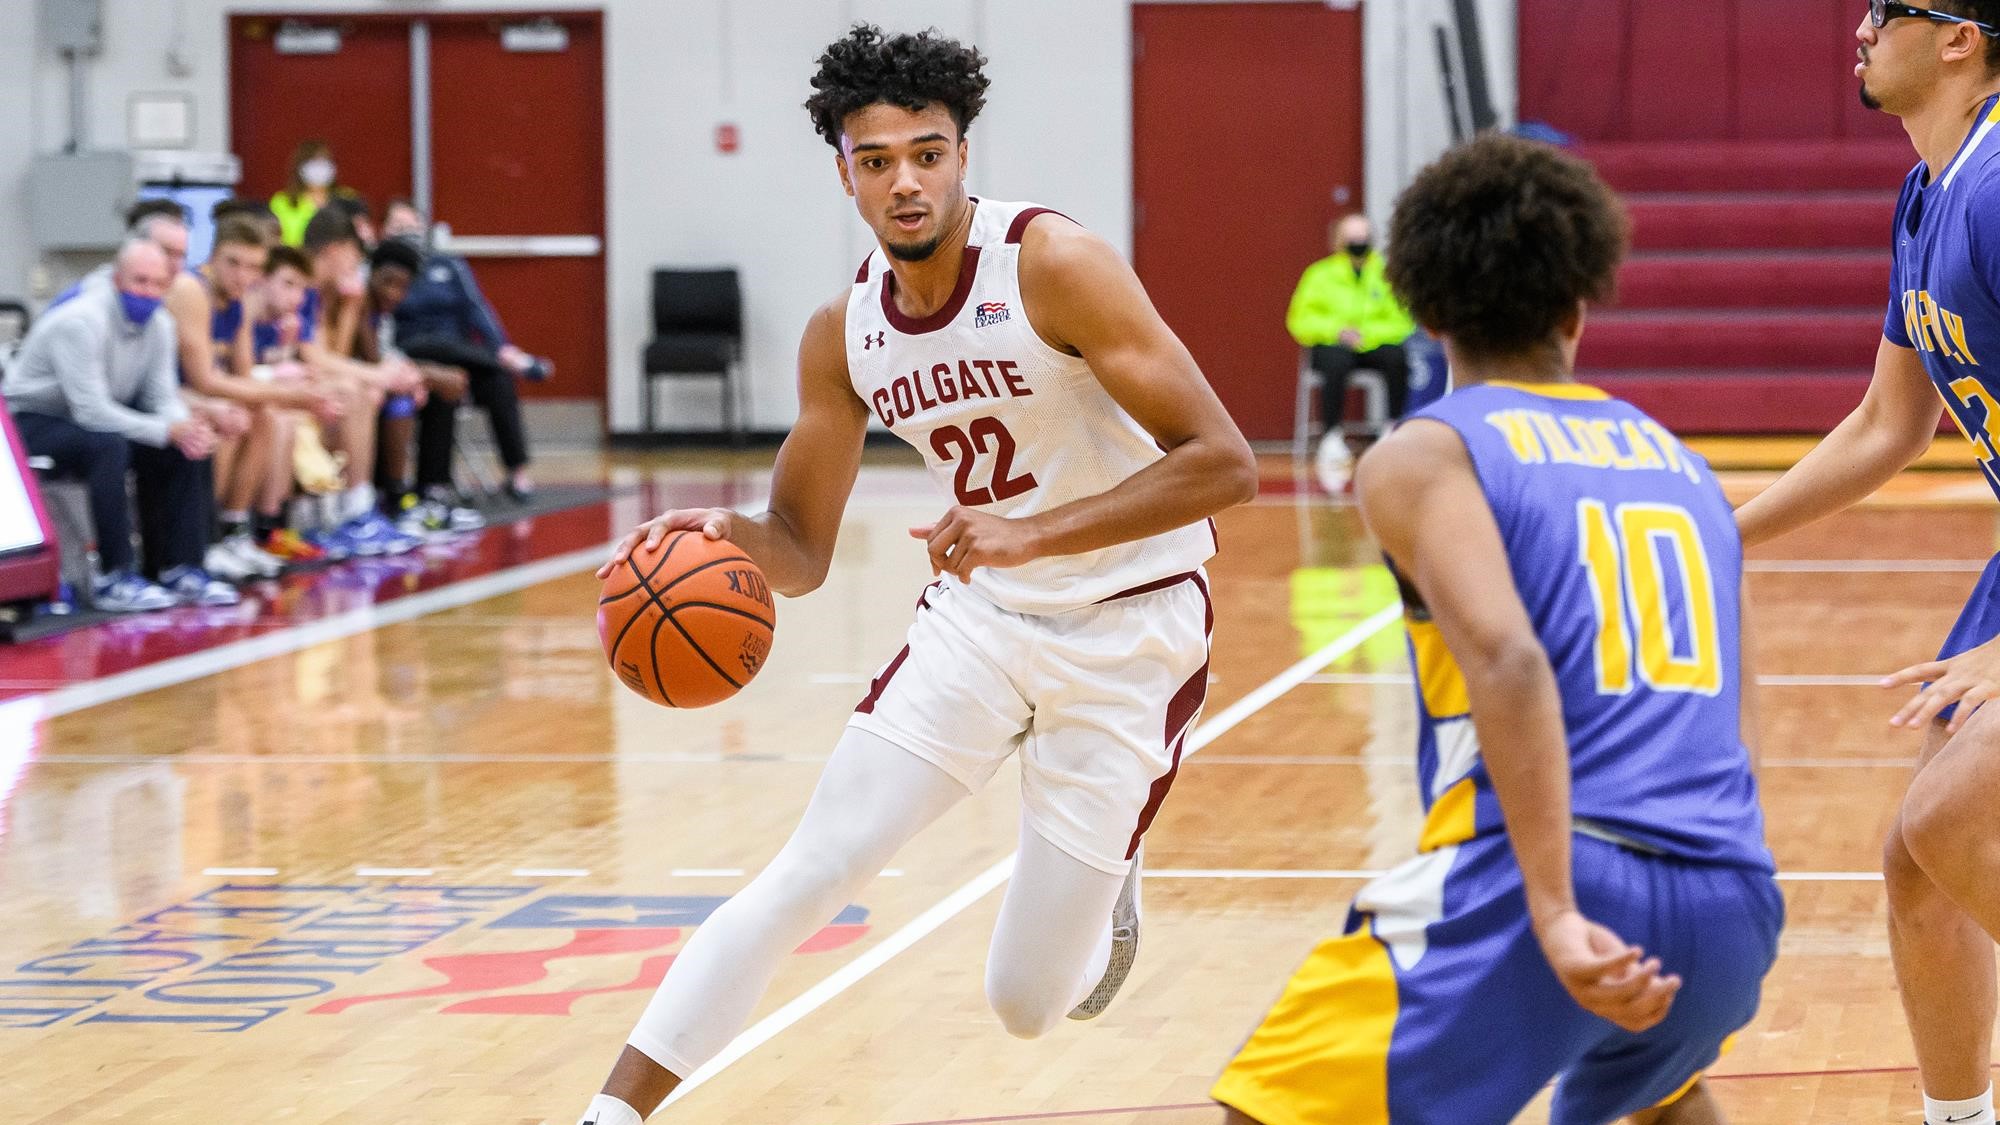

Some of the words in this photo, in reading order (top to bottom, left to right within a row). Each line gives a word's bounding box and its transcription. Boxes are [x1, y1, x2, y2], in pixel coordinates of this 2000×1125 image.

[976, 314, 1012, 328] LEAGUE
[872, 360, 1034, 428] COLGATE
[929, 416, 1039, 507] 22
[1576, 497, 1723, 698] 10
[74, 884, 545, 1032] PATRIOT
